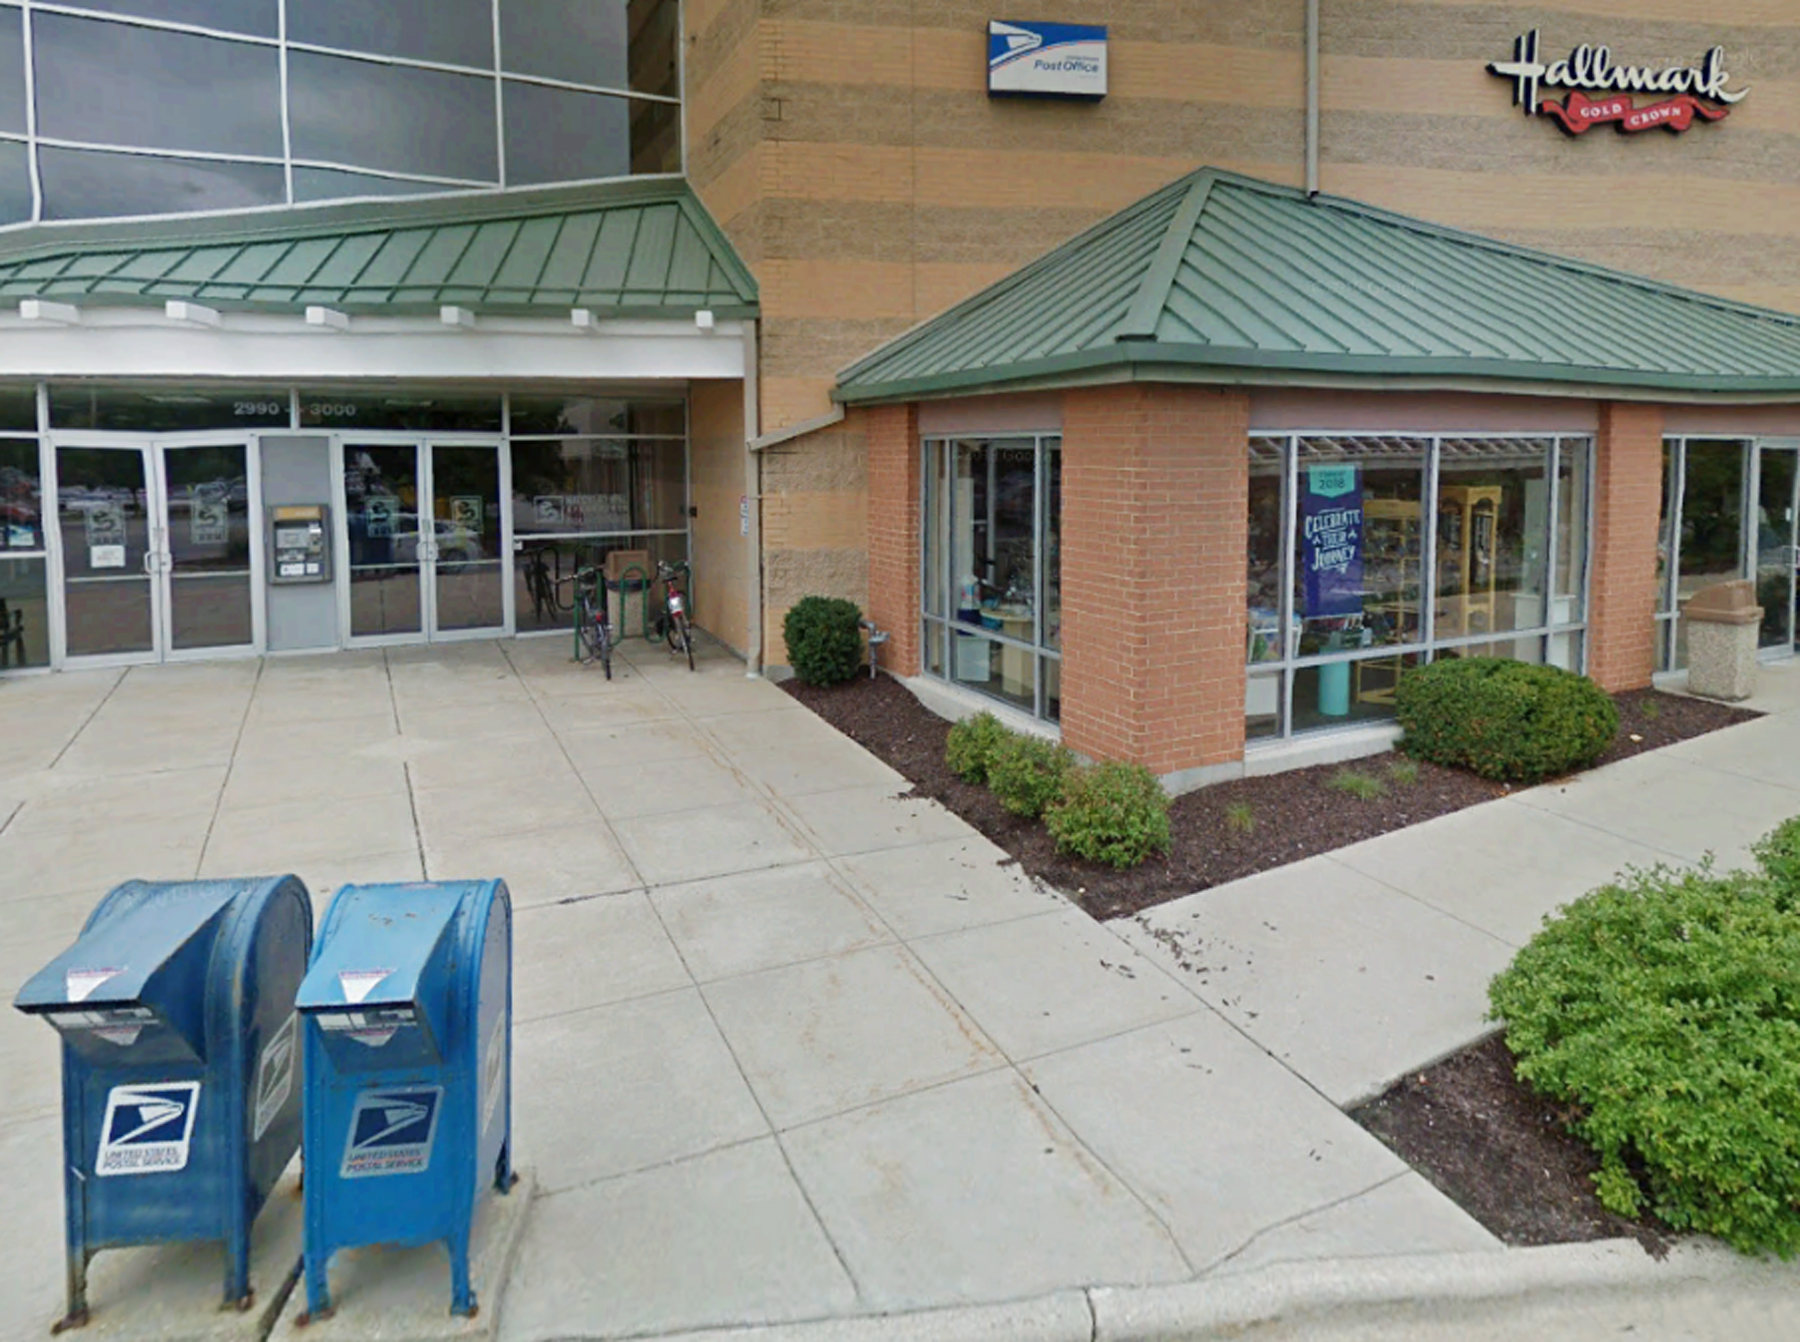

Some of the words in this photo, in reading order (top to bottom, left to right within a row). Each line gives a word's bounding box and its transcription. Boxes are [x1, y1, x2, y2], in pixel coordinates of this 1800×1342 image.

[1033, 59, 1062, 70] Post
[1063, 60, 1099, 72] Office
[1486, 29, 1750, 115] Hallmark
[1580, 102, 1623, 118] GOLD
[1630, 106, 1682, 126] CROWN
[234, 402, 280, 415] 2990
[310, 403, 357, 416] 3000
[1319, 478, 1346, 489] 2018
[1305, 509, 1361, 539] CELEBRATE
[105, 1149, 142, 1160] UNITED
[143, 1147, 178, 1157] STATES
[103, 1159, 140, 1169] POSTAL
[143, 1157, 181, 1167] SERVICE
